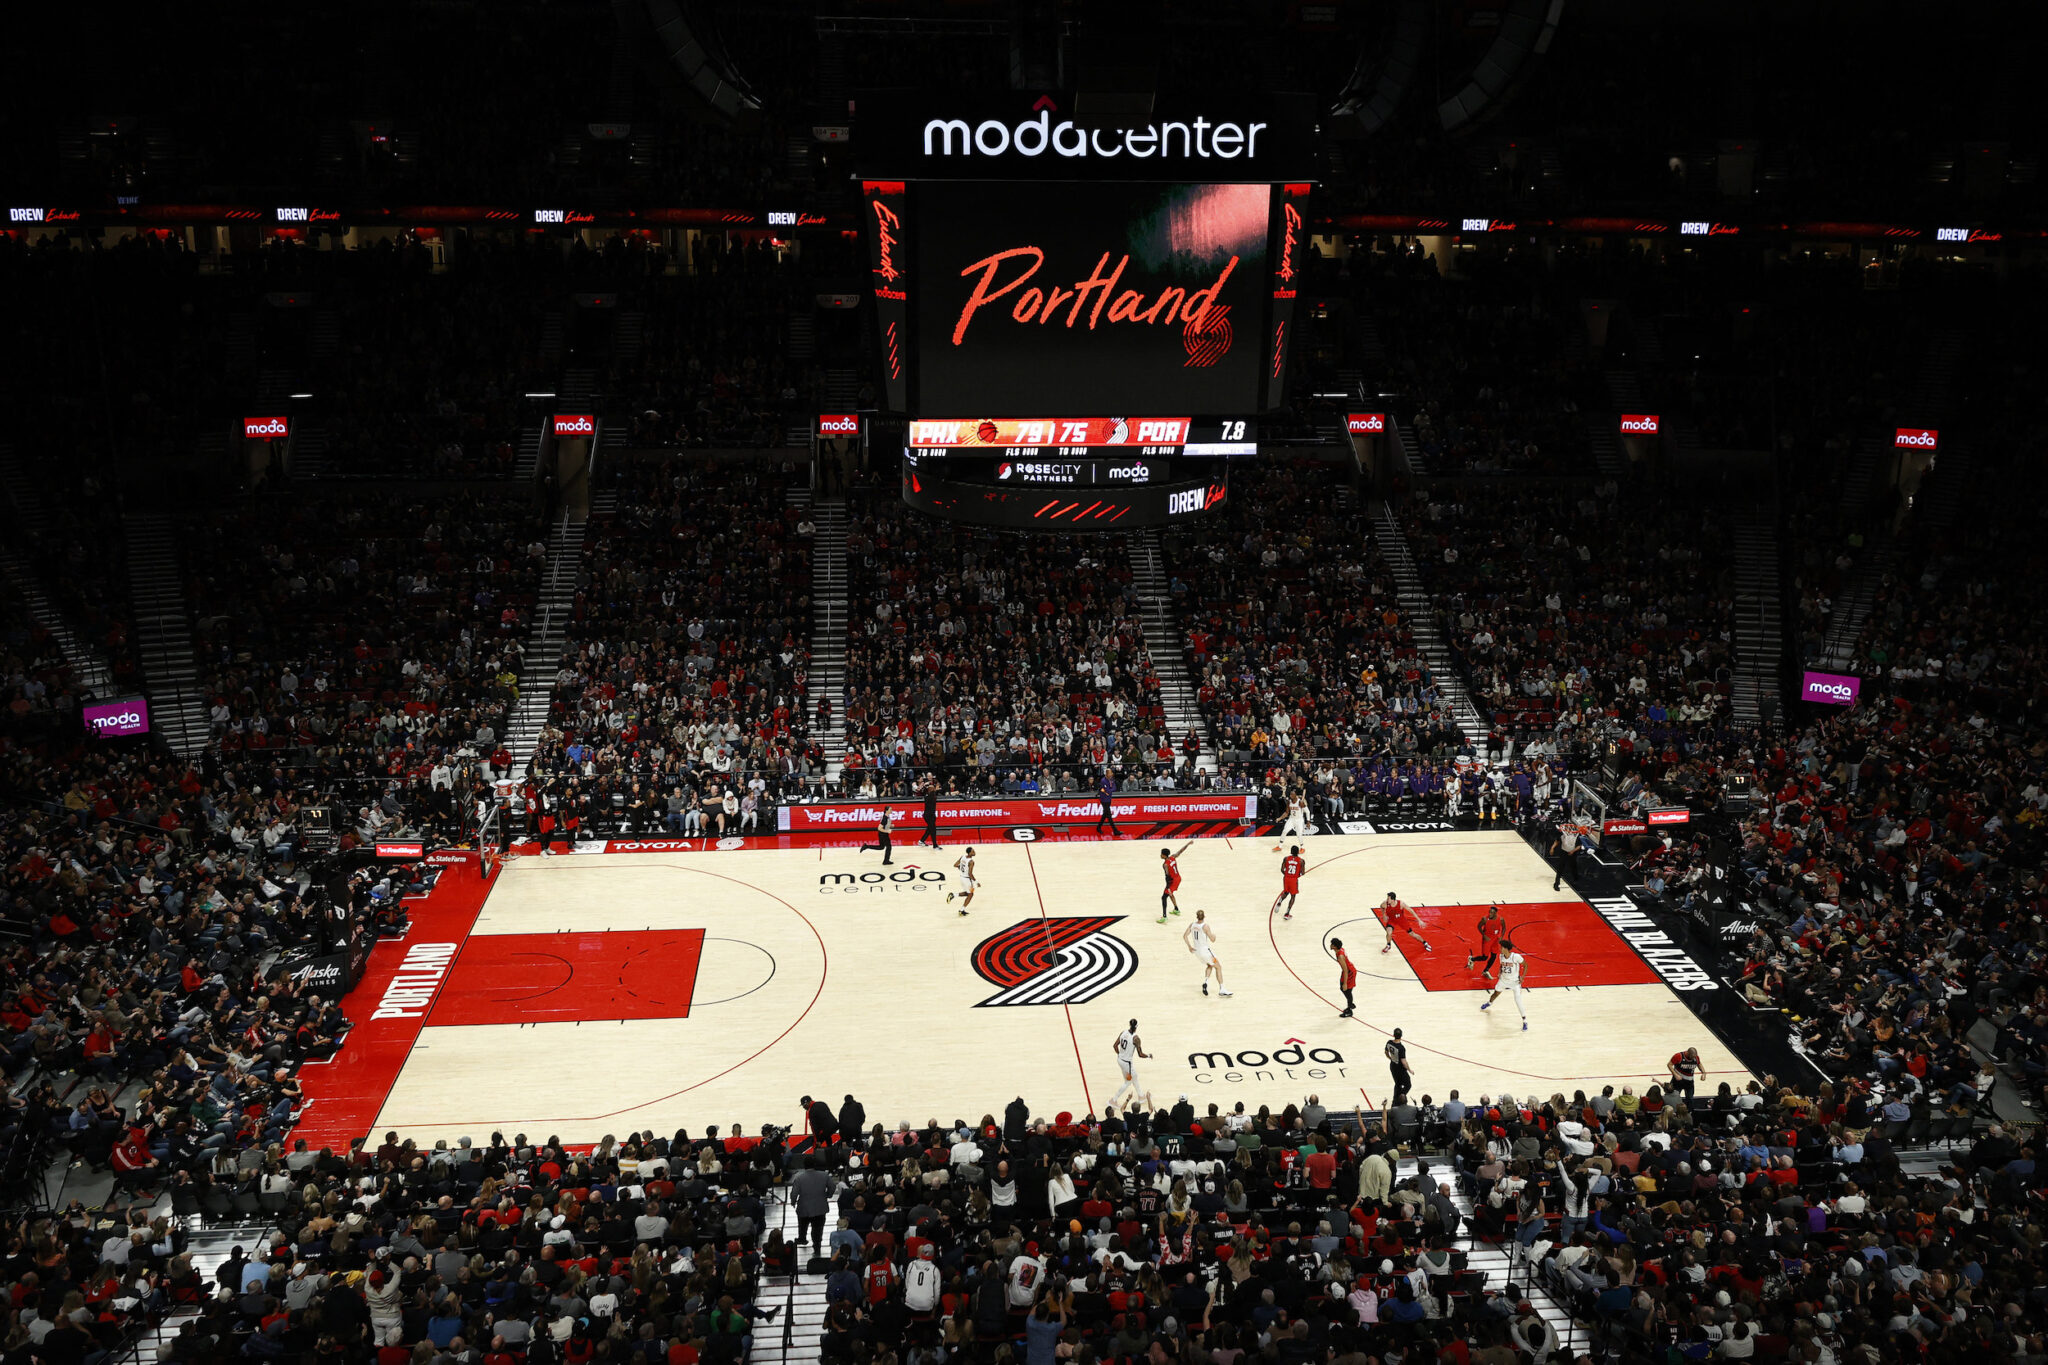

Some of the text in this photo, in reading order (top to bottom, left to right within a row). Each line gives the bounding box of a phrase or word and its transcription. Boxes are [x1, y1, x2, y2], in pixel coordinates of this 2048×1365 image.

[10, 208, 43, 221] DREW
[277, 208, 307, 221] DREW
[535, 210, 563, 222] DREW
[768, 212, 796, 224] DREW
[1462, 219, 1488, 231] DREW
[1681, 222, 1709, 234] DREW
[1937, 228, 1969, 241] DREW
[952, 246, 1239, 346] Portland
[247, 420, 286, 434] moda
[556, 418, 592, 431] moda
[821, 417, 856, 431] moda
[1350, 416, 1382, 430] moda
[1622, 418, 1656, 431] moda
[917, 423, 961, 444] PHX
[1015, 423, 1044, 443] 79
[1059, 422, 1088, 442] 75
[1137, 422, 1181, 442] POR
[1222, 421, 1246, 440] 7.8
[1897, 432, 1935, 446] moda
[1005, 448, 1020, 456] FLS
[1059, 447, 1071, 456] TO
[1142, 447, 1156, 455] FLS
[1109, 465, 1149, 478] moda
[1024, 475, 1074, 483] PARTNERS
[1169, 487, 1205, 515] DREW
[1809, 683, 1851, 696] moda
[93, 712, 140, 728] moda
[940, 810, 957, 818] FOR
[959, 809, 1002, 818] EVERYONE
[1143, 805, 1168, 813] FRESH
[1189, 804, 1231, 812] EVERYONE
[1377, 822, 1454, 831] TOYOTA
[1012, 828, 1035, 841] 6
[613, 841, 692, 850] TOYOTA
[820, 868, 945, 885] moda
[819, 883, 945, 894] center
[1720, 920, 1758, 935] Alask
[1588, 894, 1719, 991] TRAIL BLAZERS
[290, 964, 340, 979] Alaska
[370, 943, 458, 1021] PORTLAND
[1188, 1044, 1345, 1069] moda
[1195, 1067, 1349, 1085] center
[1140, 1198, 1156, 1211] 77
[917, 1272, 924, 1286] 0
